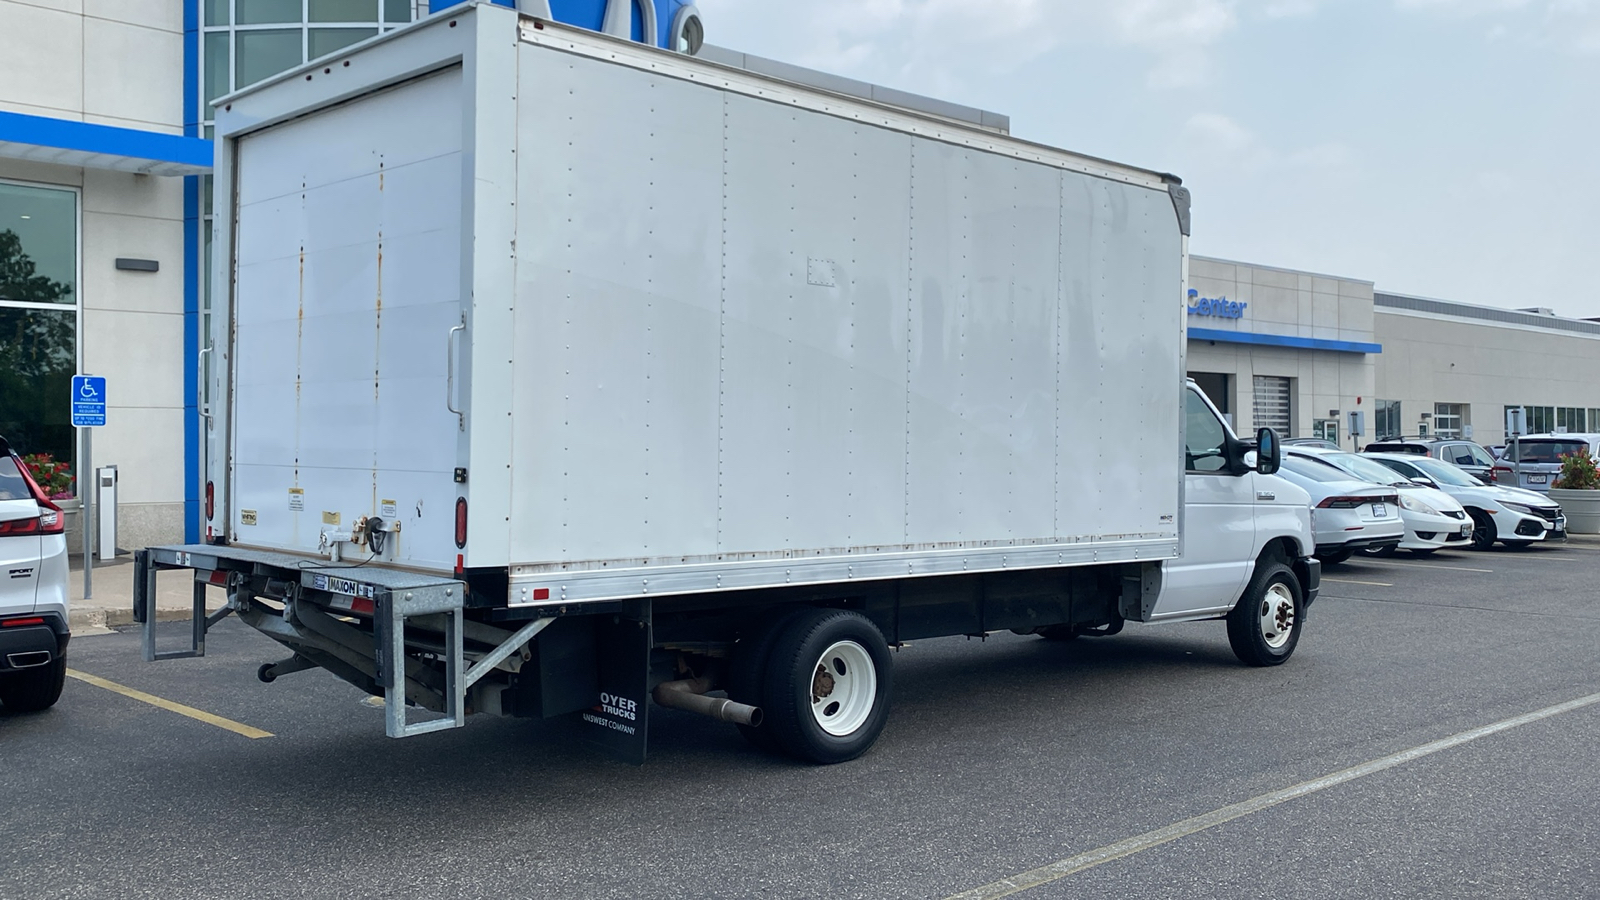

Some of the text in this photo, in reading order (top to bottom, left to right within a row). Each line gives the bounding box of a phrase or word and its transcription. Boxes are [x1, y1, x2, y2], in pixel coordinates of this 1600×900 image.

[1188, 289, 1247, 319] Center
[331, 578, 356, 595] MAXON
[602, 703, 636, 721] TRUCKS
[608, 720, 635, 735] COMPANY
